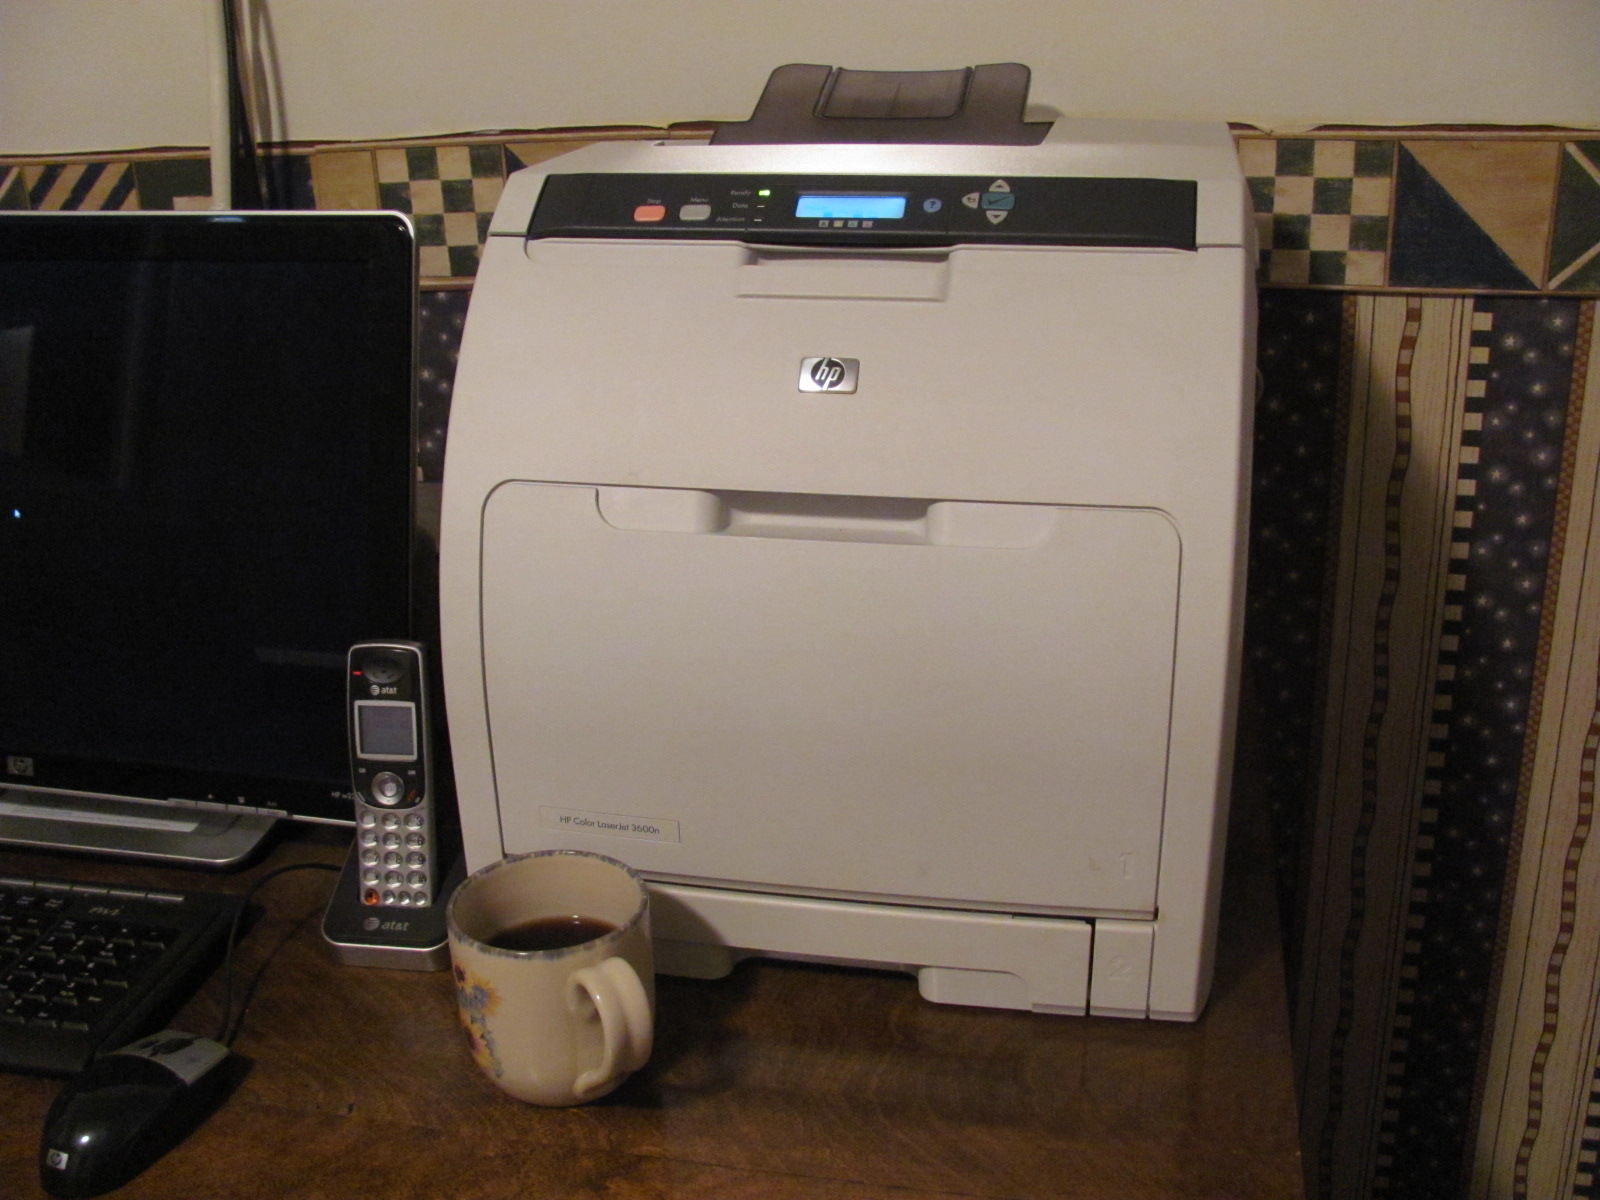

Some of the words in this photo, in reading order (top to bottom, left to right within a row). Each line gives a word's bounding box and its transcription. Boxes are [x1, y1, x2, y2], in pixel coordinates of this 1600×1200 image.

[647, 197, 662, 205] Stop
[811, 357, 845, 391] hp
[559, 815, 572, 824] HP
[572, 816, 596, 828] Color
[597, 819, 630, 832] LaserJet
[631, 823, 660, 835] 3600n
